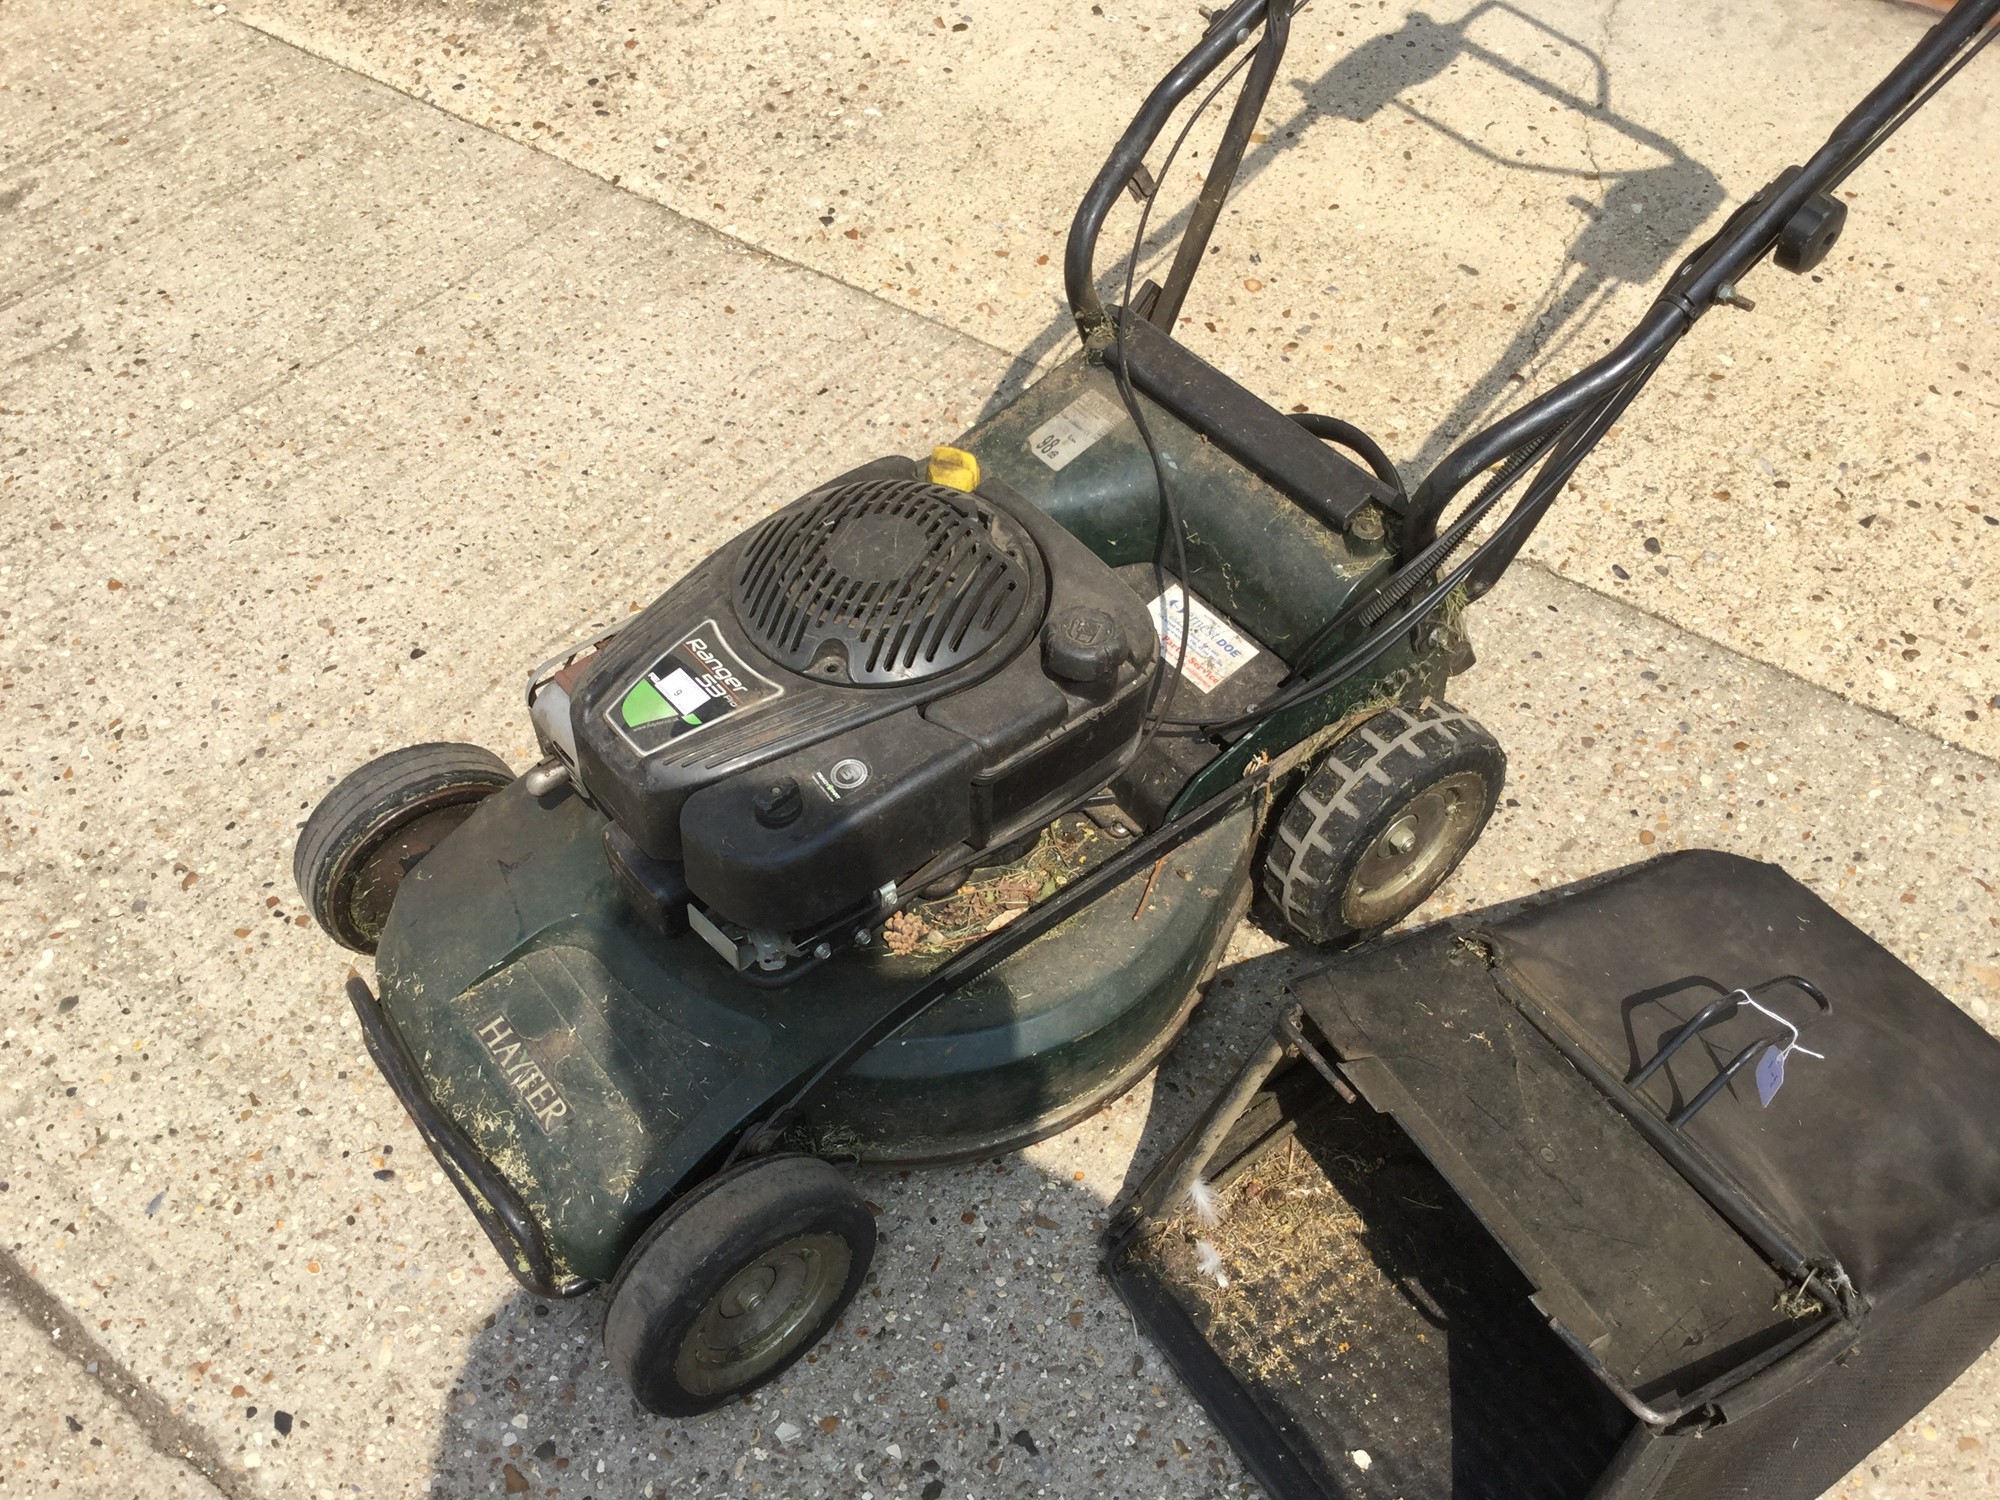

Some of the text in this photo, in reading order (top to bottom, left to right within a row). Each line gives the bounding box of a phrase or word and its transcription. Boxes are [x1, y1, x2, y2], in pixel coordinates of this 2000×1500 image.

[1036, 434, 1061, 454] 98
[1216, 638, 1242, 658] DOE
[685, 638, 749, 692] Ranger
[1187, 657, 1219, 684] Service
[694, 673, 727, 699] 53
[478, 1015, 568, 1131] HAYTER
